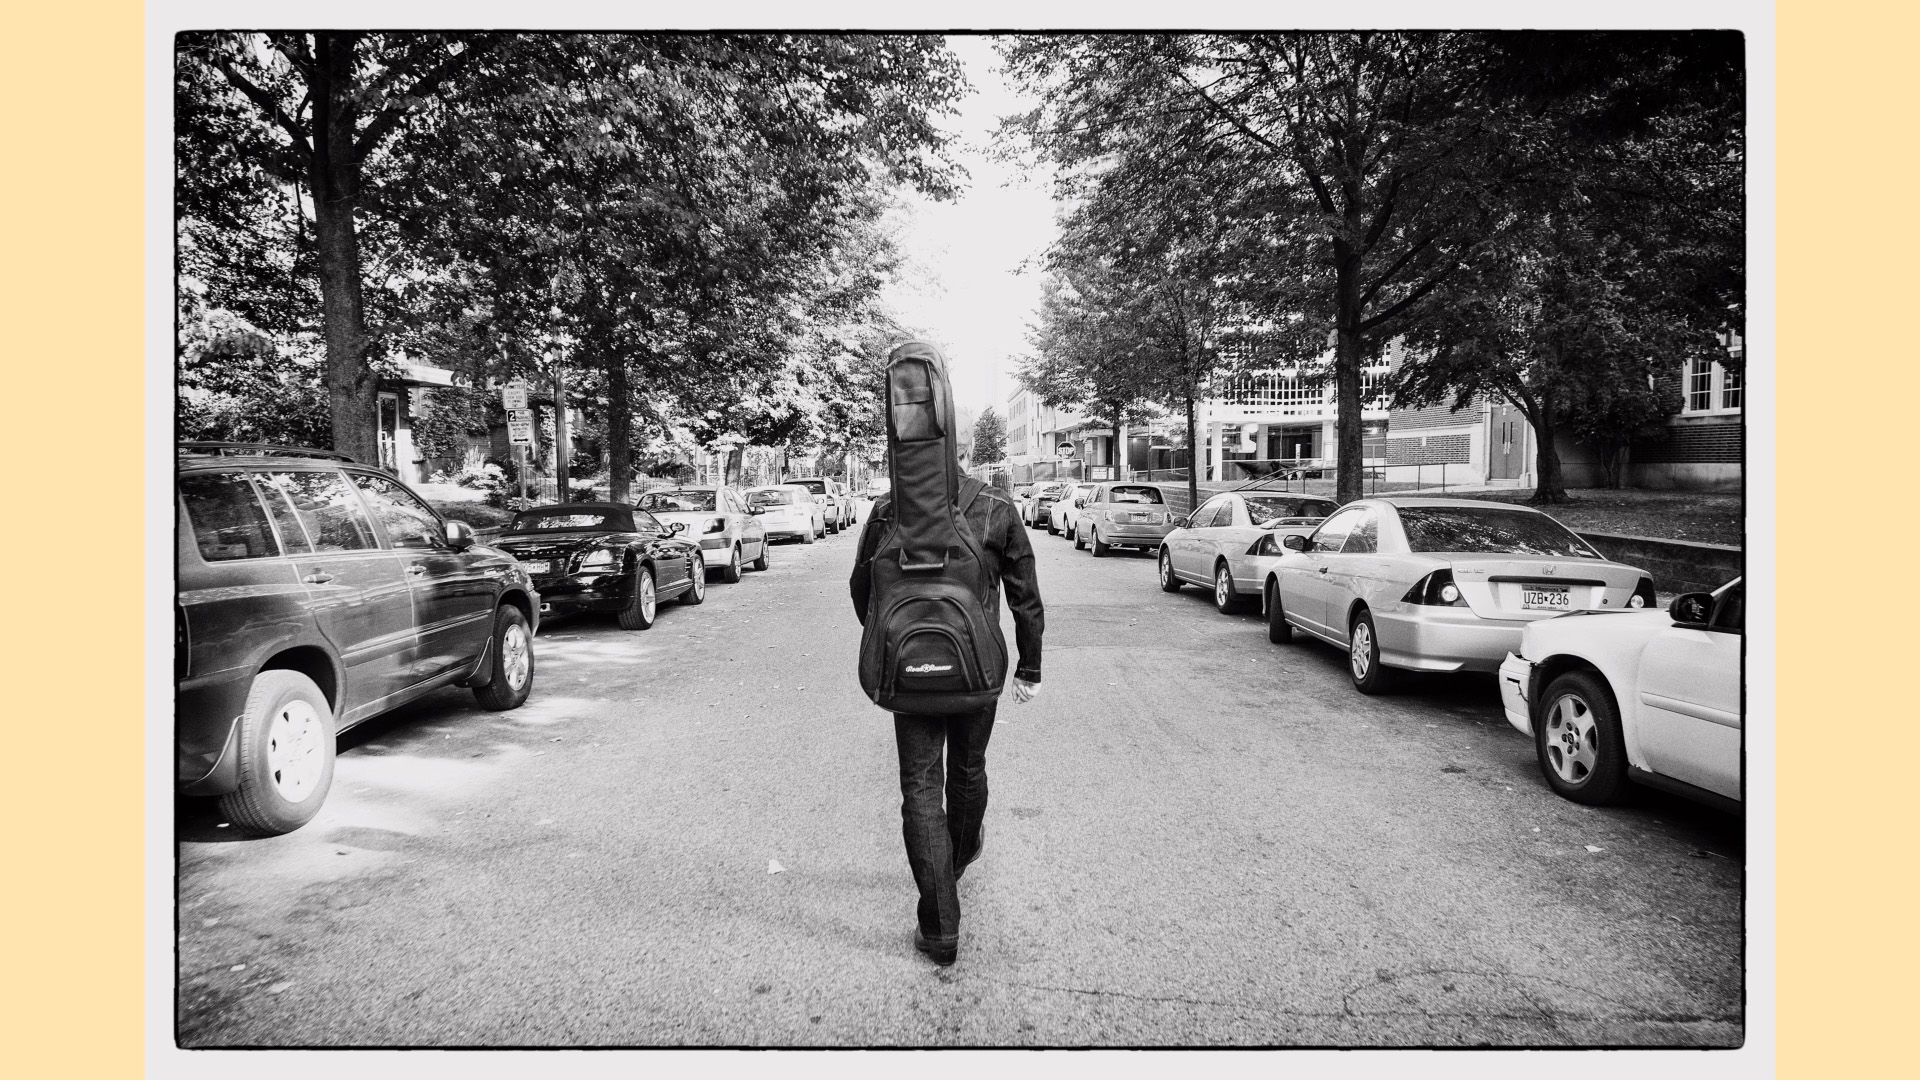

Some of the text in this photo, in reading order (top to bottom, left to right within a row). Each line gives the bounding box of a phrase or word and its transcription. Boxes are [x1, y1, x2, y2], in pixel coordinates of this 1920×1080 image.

[1502, 407, 1507, 416] 2
[509, 412, 515, 421] 2
[1058, 447, 1075, 455] STOP
